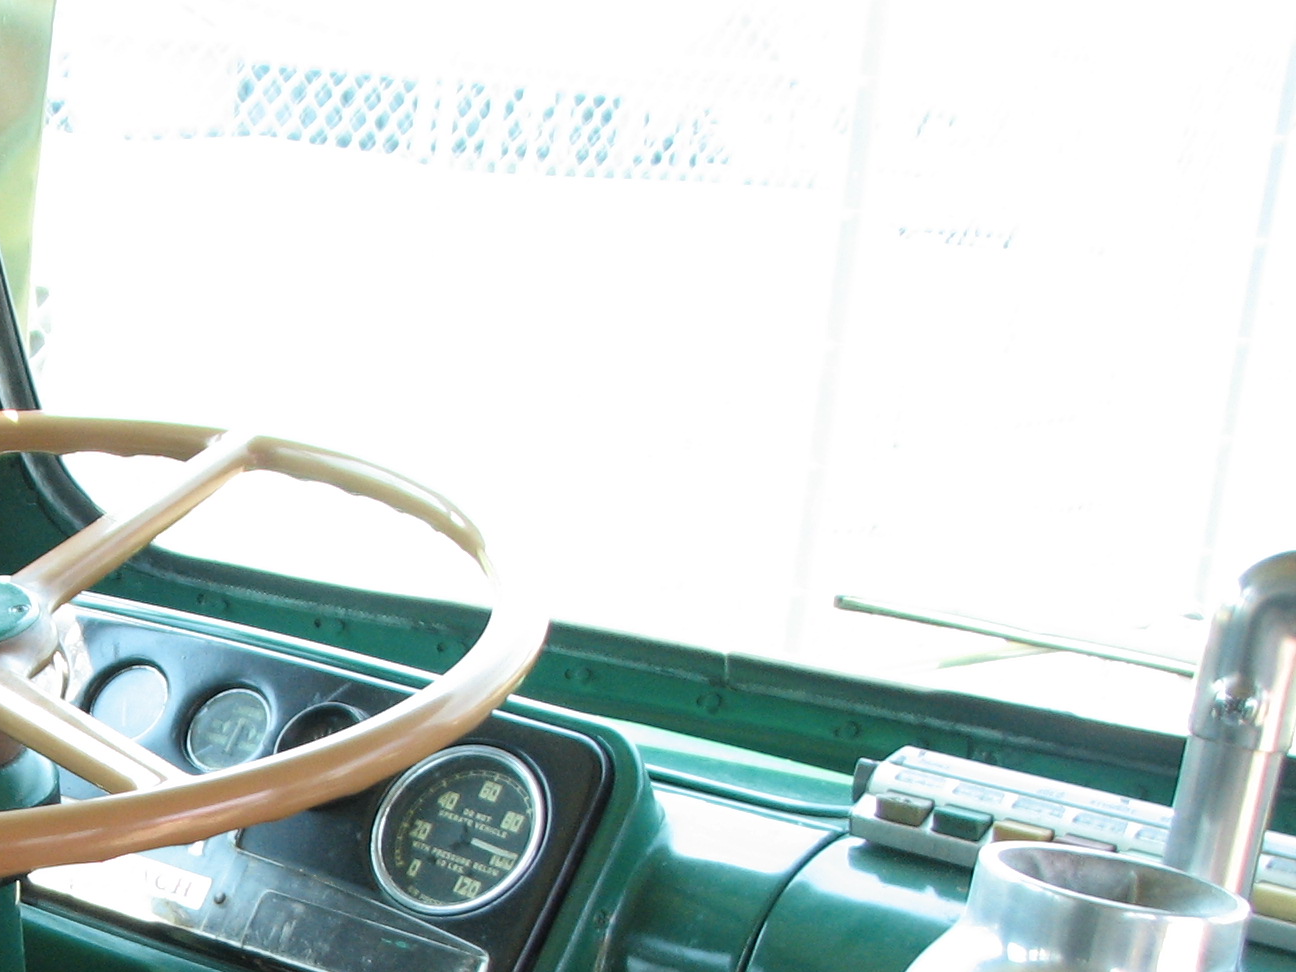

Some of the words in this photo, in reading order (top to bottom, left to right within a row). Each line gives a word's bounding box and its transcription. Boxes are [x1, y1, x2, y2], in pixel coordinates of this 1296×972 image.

[438, 791, 461, 811] 40
[479, 781, 502, 802] 60
[438, 810, 473, 827] OPERATE
[474, 823, 509, 839] VEHICLE
[463, 808, 475, 818] DO
[475, 811, 493, 823] NOT
[500, 811, 526, 833] 80
[409, 819, 432, 841] 20
[406, 858, 422, 878] 0
[431, 846, 472, 868] PRESSURE
[472, 861, 500, 877] BELOW
[454, 875, 482, 898] 120
